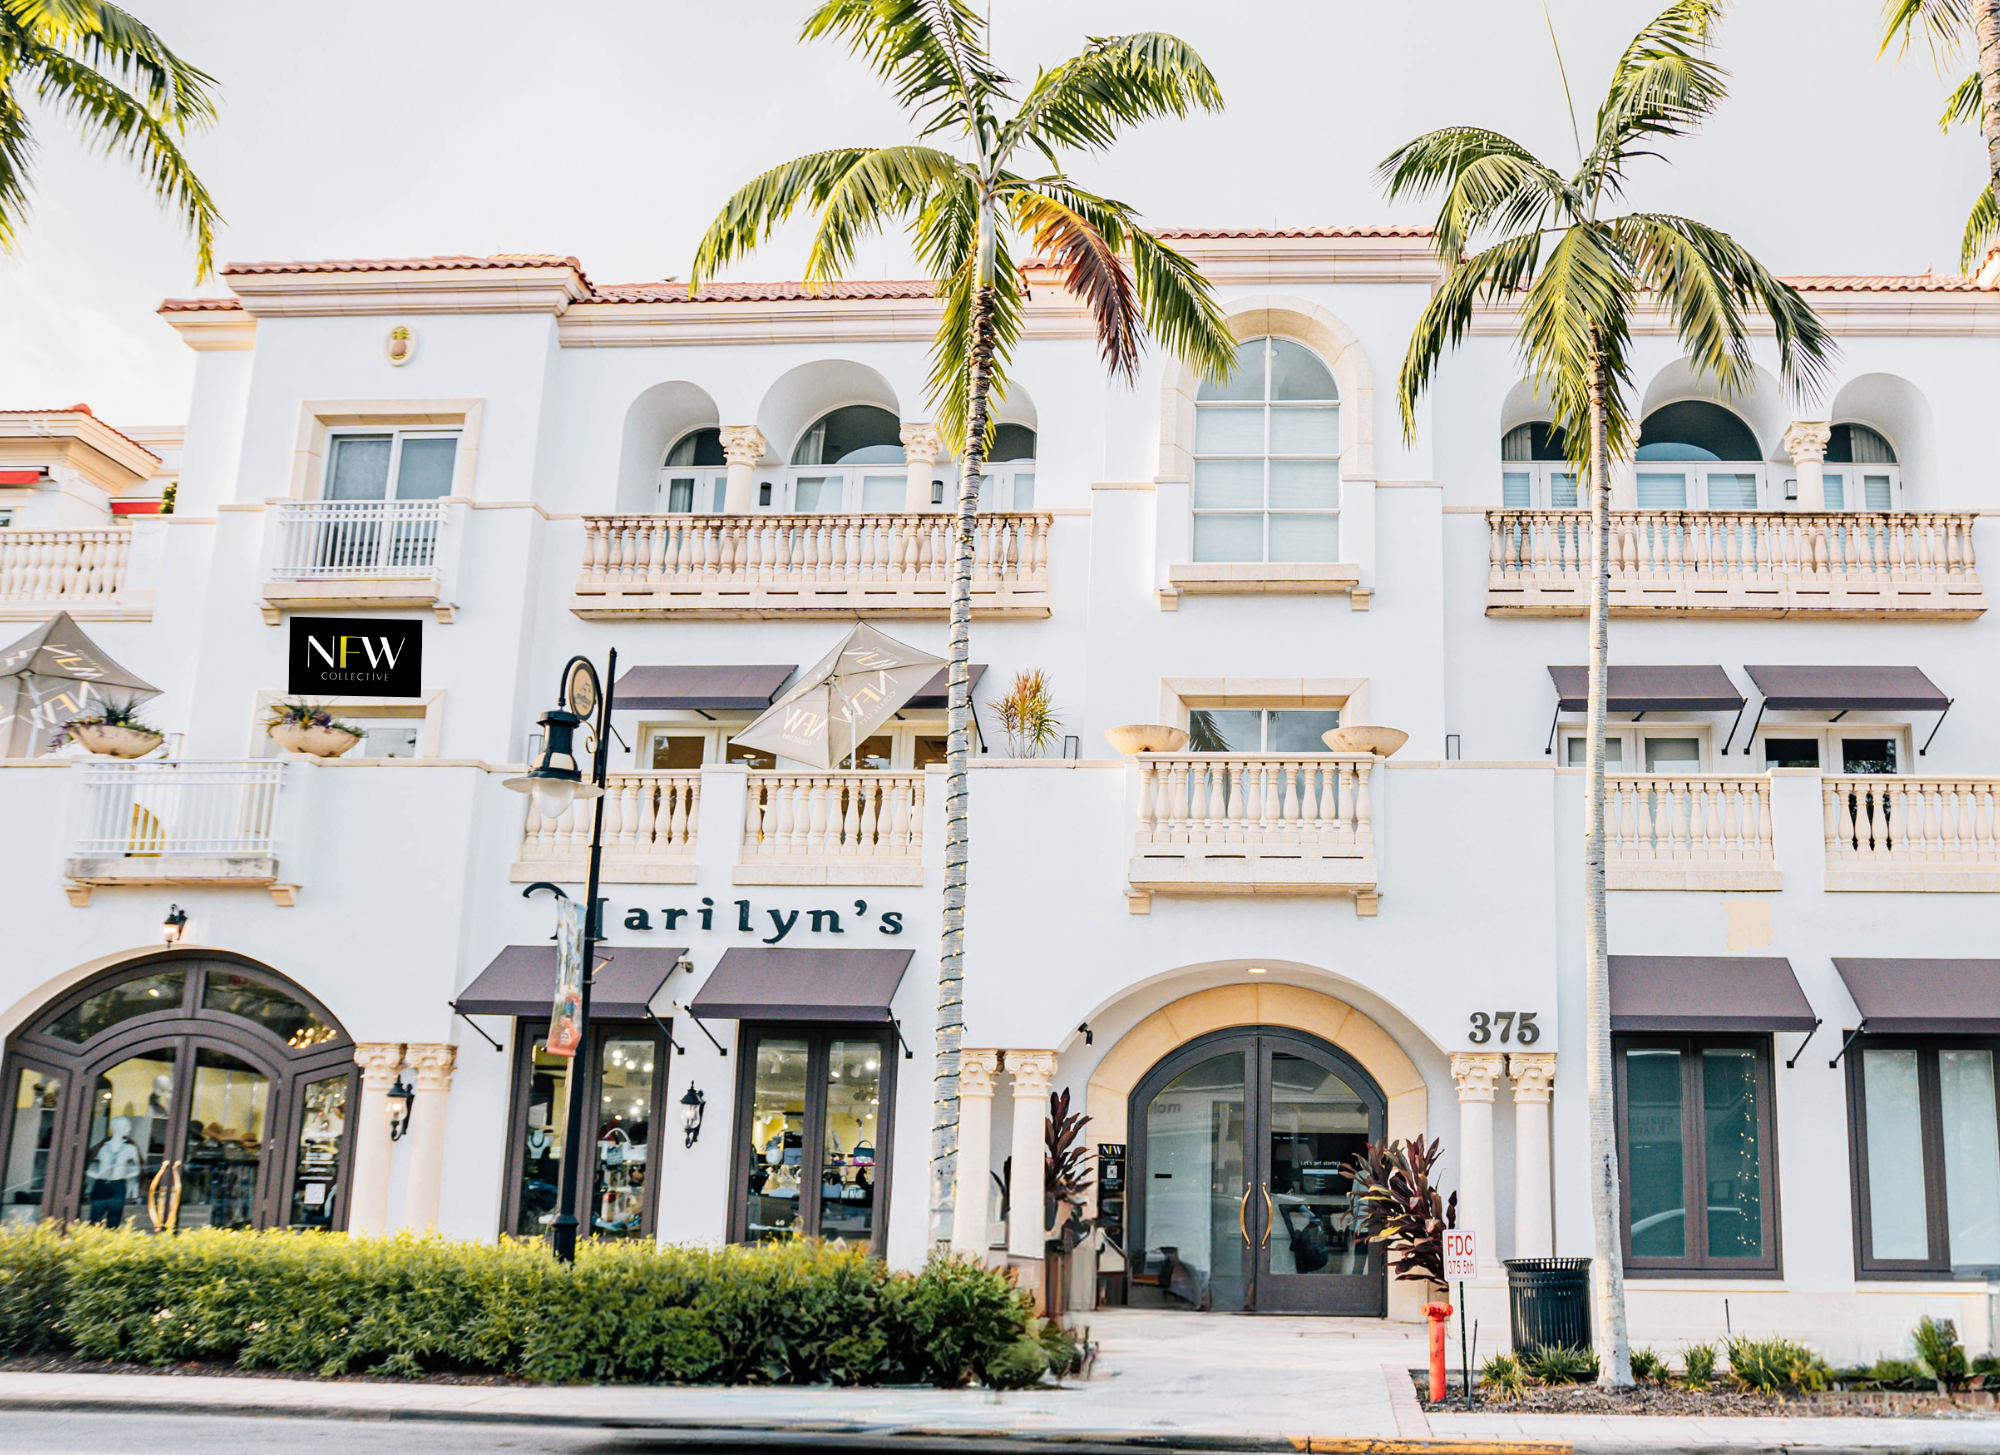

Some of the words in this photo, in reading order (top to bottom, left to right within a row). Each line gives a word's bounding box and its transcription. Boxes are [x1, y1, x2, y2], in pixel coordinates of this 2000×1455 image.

[307, 635, 406, 670] NFW
[320, 671, 389, 682] COLLECTIVE
[1468, 1011, 1540, 1045] 375
[1447, 1234, 1473, 1257] FDC
[1448, 1260, 1462, 1275] 375
[1463, 1260, 1475, 1274] 5th
